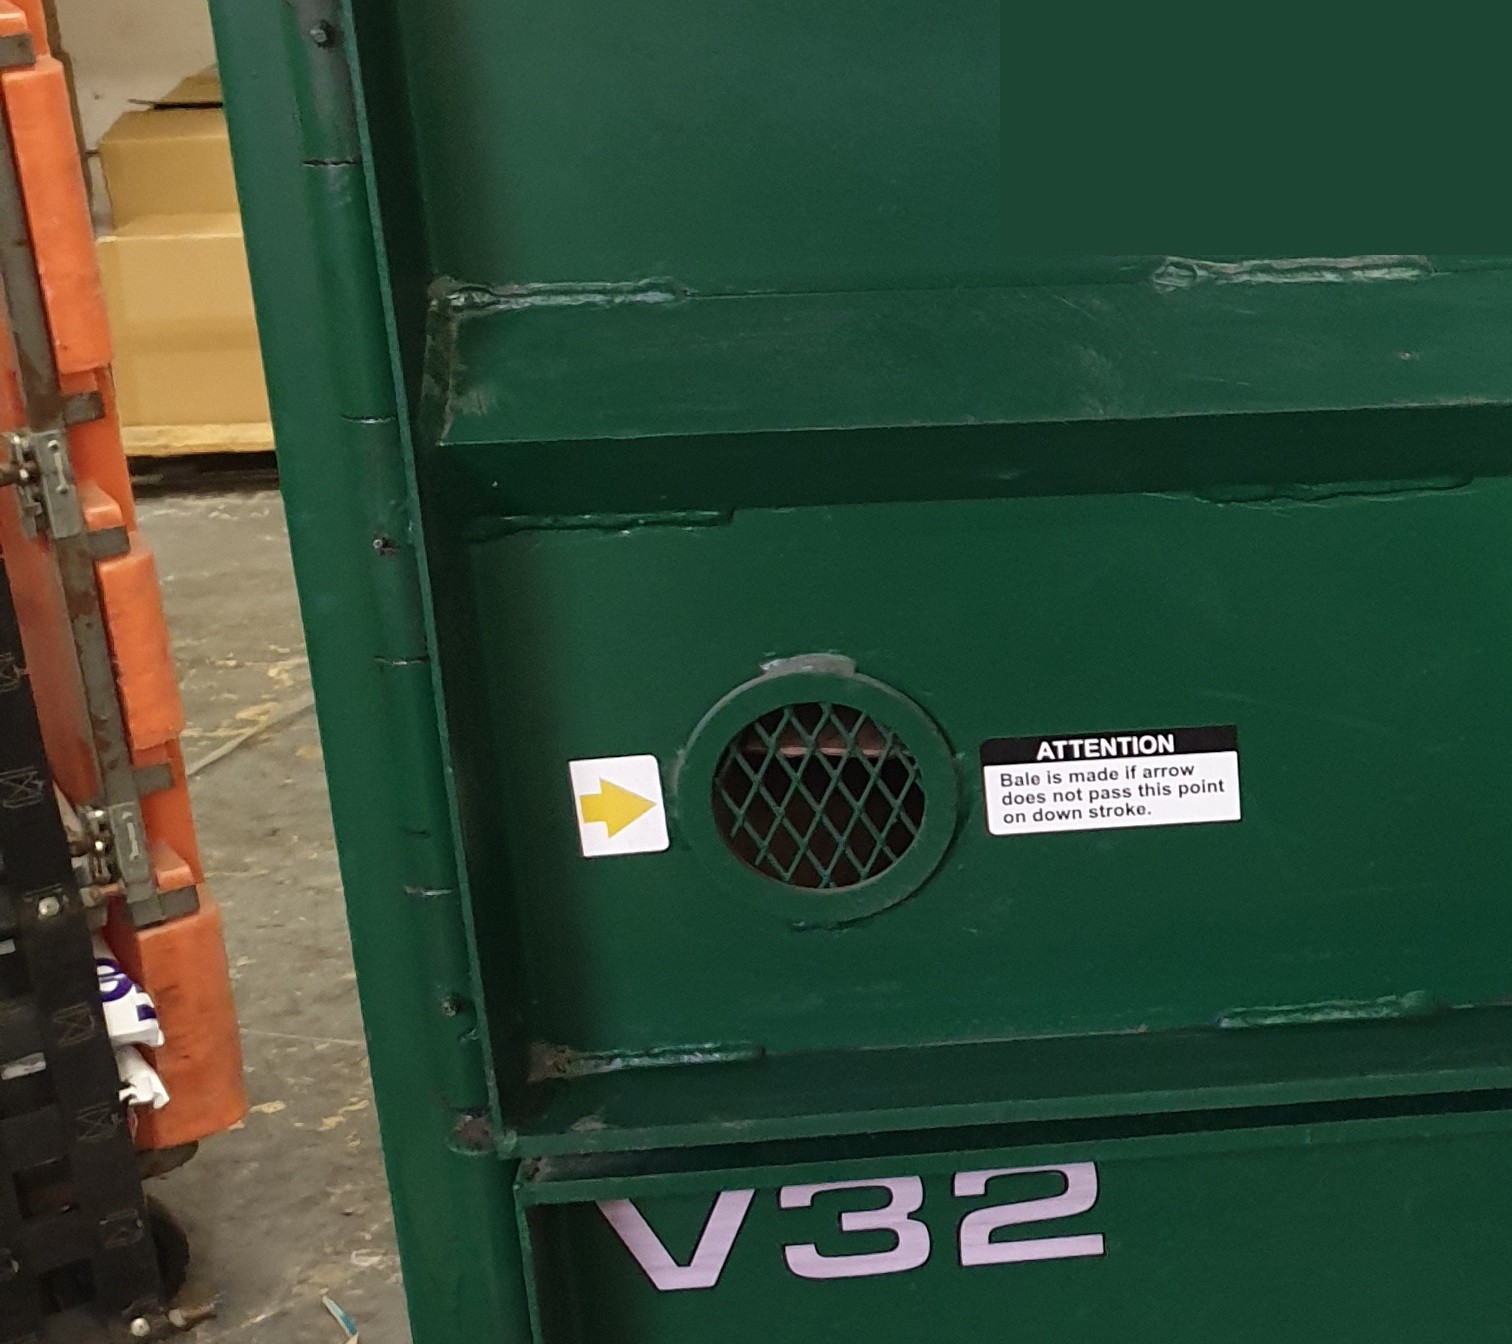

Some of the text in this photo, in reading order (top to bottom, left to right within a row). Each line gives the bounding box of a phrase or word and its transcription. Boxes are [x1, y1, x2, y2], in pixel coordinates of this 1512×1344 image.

[1037, 734, 1174, 761] ATTENTION
[1000, 764, 1194, 787] Bale is made if arrow
[1002, 779, 1225, 805] does not pass this point
[1003, 803, 1152, 824] on down stroke.
[595, 1161, 1105, 1291] V32
